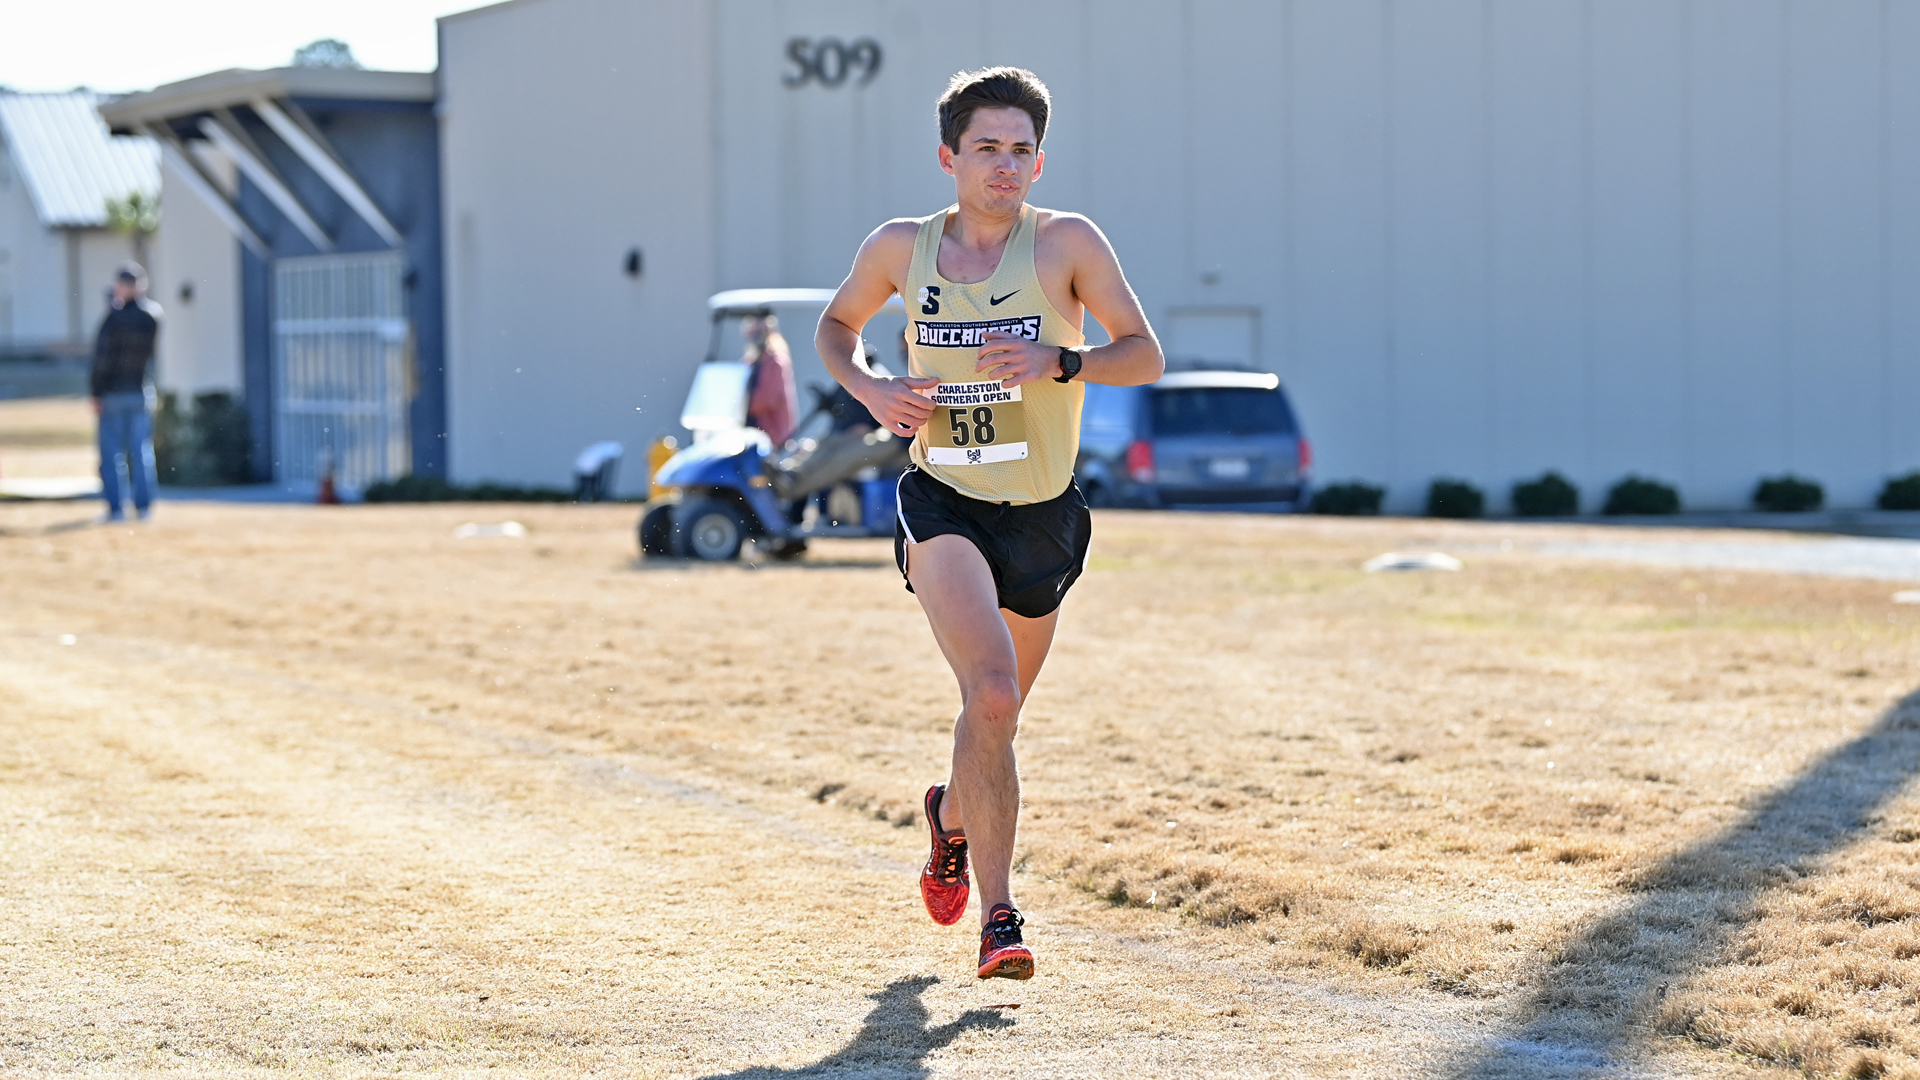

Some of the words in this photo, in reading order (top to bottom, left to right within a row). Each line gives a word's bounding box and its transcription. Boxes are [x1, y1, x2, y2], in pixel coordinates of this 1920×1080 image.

[781, 36, 883, 90] 509
[989, 319, 1019, 327] UNIVERSITY
[937, 382, 1001, 394] CHARLESTON
[931, 394, 980, 404] SOUTHERN
[983, 392, 1011, 402] OPEN
[949, 406, 996, 446] 58
